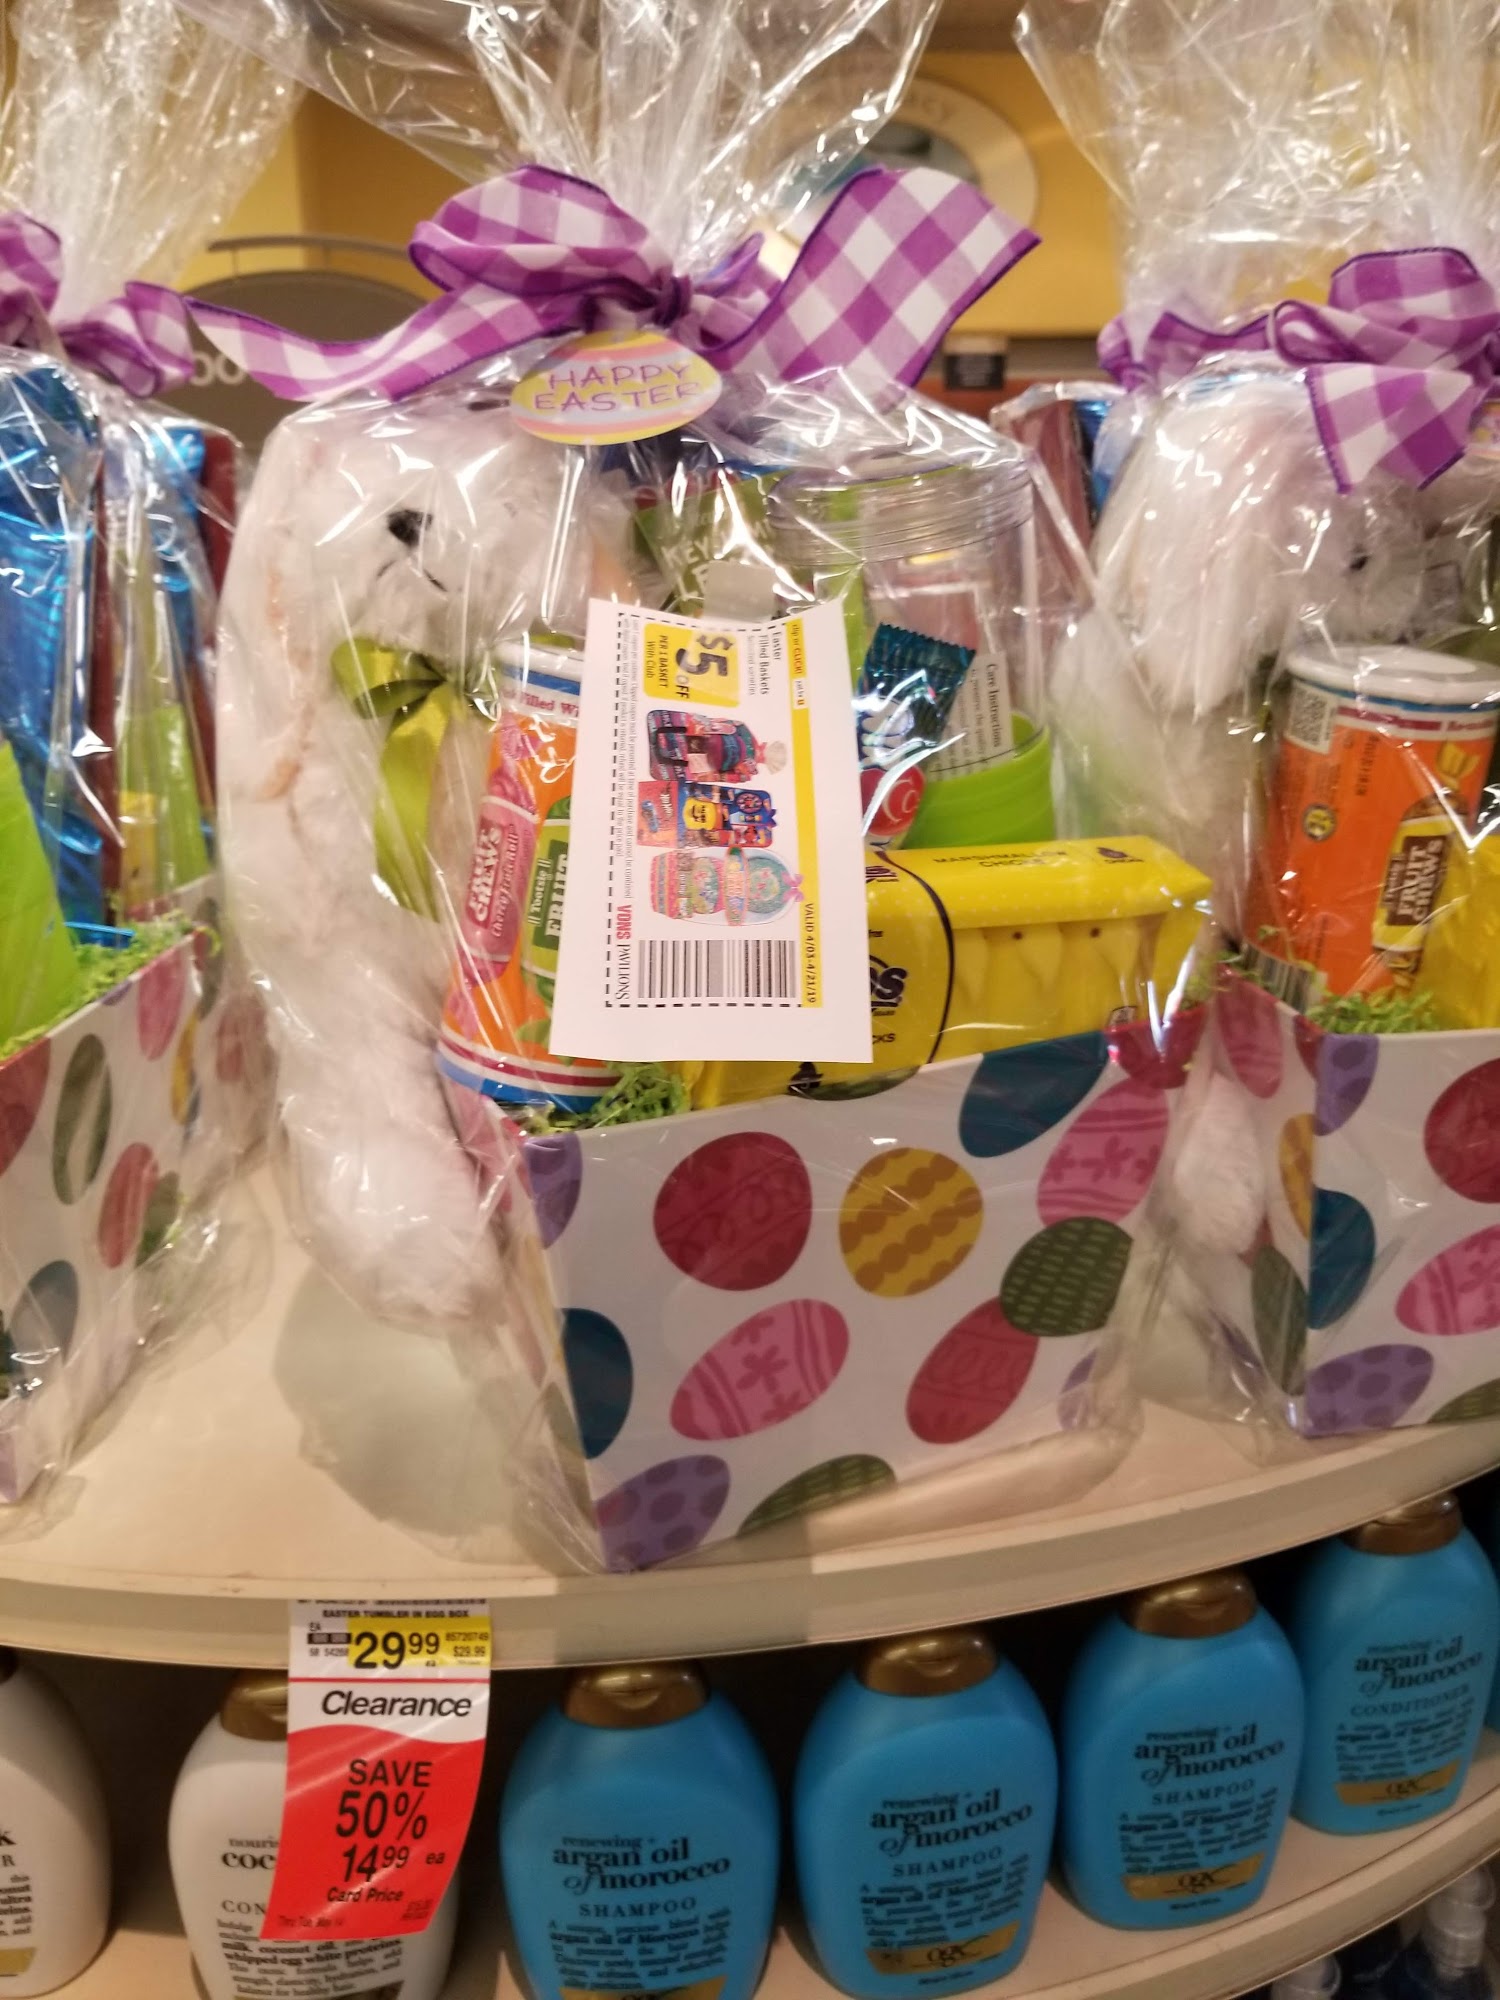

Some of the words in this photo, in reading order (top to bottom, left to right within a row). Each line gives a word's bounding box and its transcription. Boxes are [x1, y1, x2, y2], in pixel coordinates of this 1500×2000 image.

[549, 364, 689, 390] HAPPY
[534, 382, 700, 412] EASTER
[647, 640, 656, 658] With
[659, 635, 669, 648] PER
[759, 635, 770, 658] Filled
[772, 632, 782, 660] Easter
[646, 660, 657, 678] Club
[659, 658, 669, 688] BASKET
[792, 648, 803, 674] CLICK!
[675, 674, 690, 699] OFF
[760, 662, 771, 695] Baskets
[986, 664, 1000, 688] Care
[988, 689, 1004, 748] Instructions
[475, 827, 503, 922] CHEWS
[1397, 845, 1426, 915] FRUIT
[530, 870, 548, 913] Tootsie
[616, 905, 632, 940] VONS
[805, 903, 815, 932] VALID
[615, 944, 631, 1000] PAVILIONS
[1355, 1653, 1428, 1675] argan
[321, 1690, 472, 1717] Clearance
[1134, 1741, 1216, 1765] argan
[1224, 1723, 1257, 1749] oil
[1174, 1739, 1285, 1778] morocco
[349, 1759, 433, 1787] SAVE
[1152, 1778, 1256, 1805] SHAMPOO
[336, 1791, 428, 1840] 50%
[871, 1808, 956, 1834] argan
[965, 1789, 1000, 1818] oil
[914, 1804, 1032, 1848] morocco
[426, 1852, 446, 1864] ea
[553, 1849, 640, 1874] argan
[651, 1837, 689, 1864] oil
[893, 1846, 1002, 1877] SHAMPOO
[600, 1858, 731, 1889] morocco
[327, 1887, 362, 1902] Card
[366, 1887, 404, 1902] Price
[579, 1897, 696, 1917] SHAMPOO
